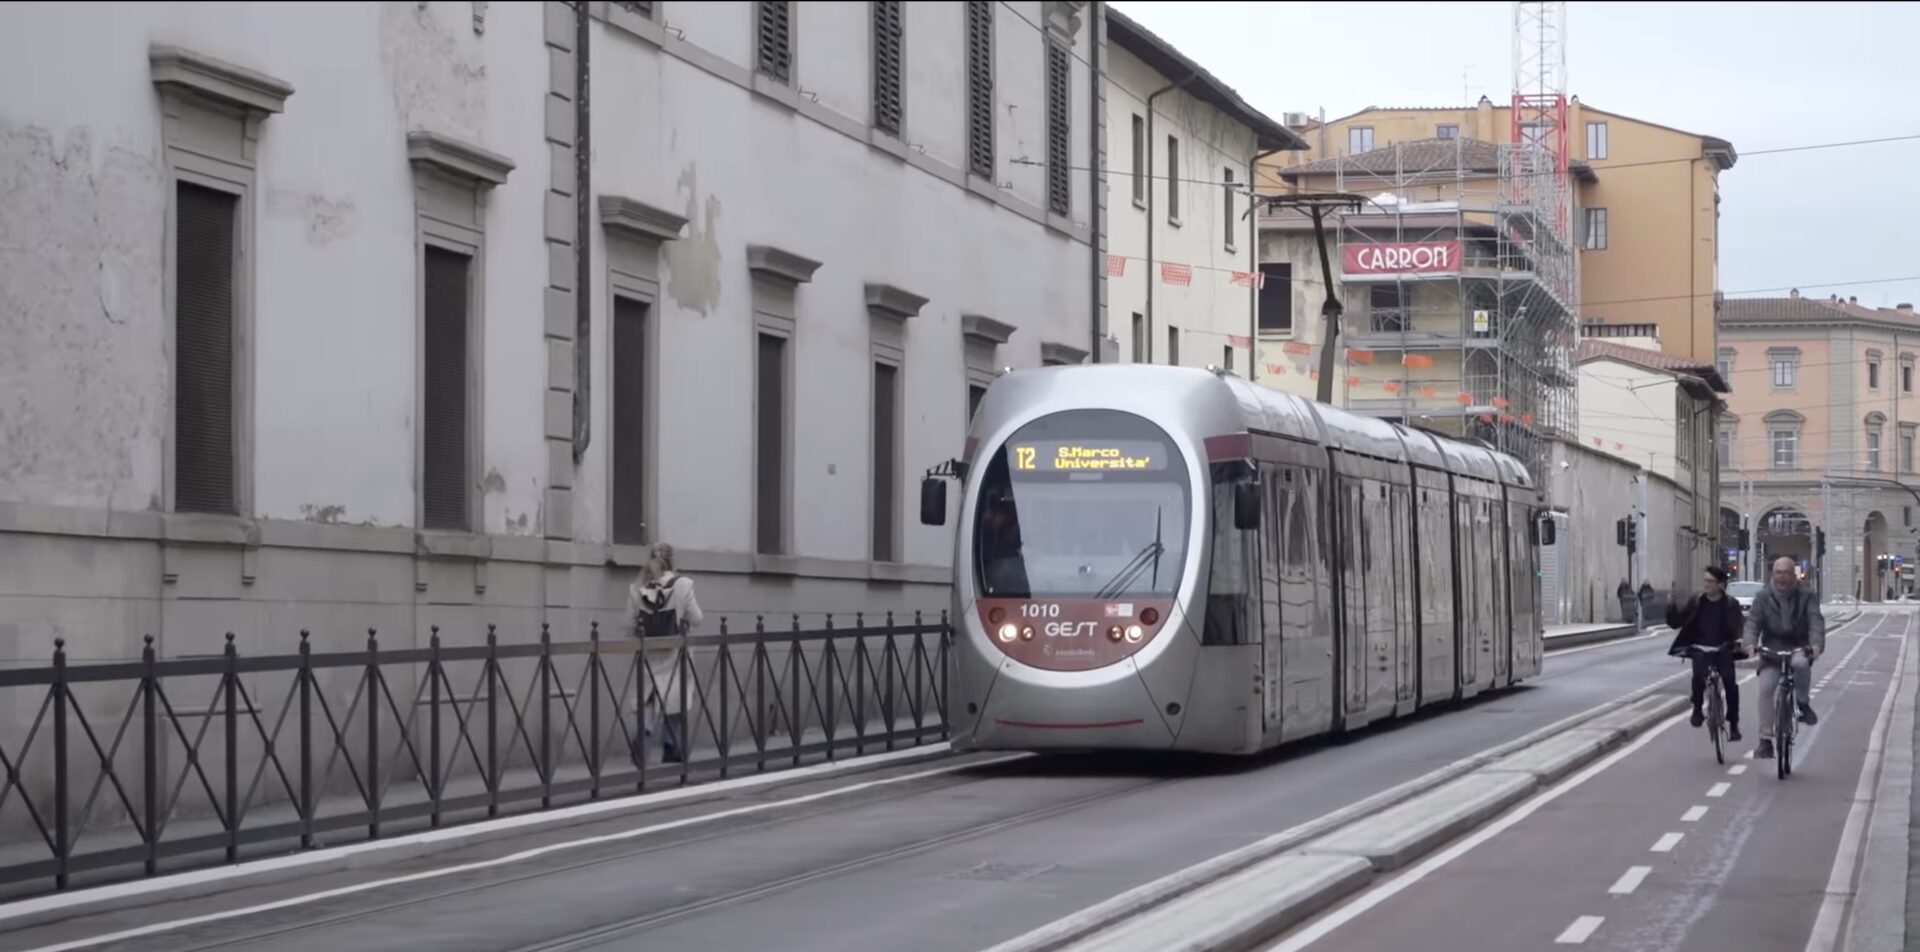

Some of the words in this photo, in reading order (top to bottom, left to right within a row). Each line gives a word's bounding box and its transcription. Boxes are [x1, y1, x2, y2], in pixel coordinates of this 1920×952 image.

[1357, 246, 1447, 270] CARRON
[1016, 447, 1036, 469] T2
[1058, 447, 1120, 457] S.Marco
[1020, 604, 1060, 617] 1010
[1045, 622, 1098, 636] GEST
